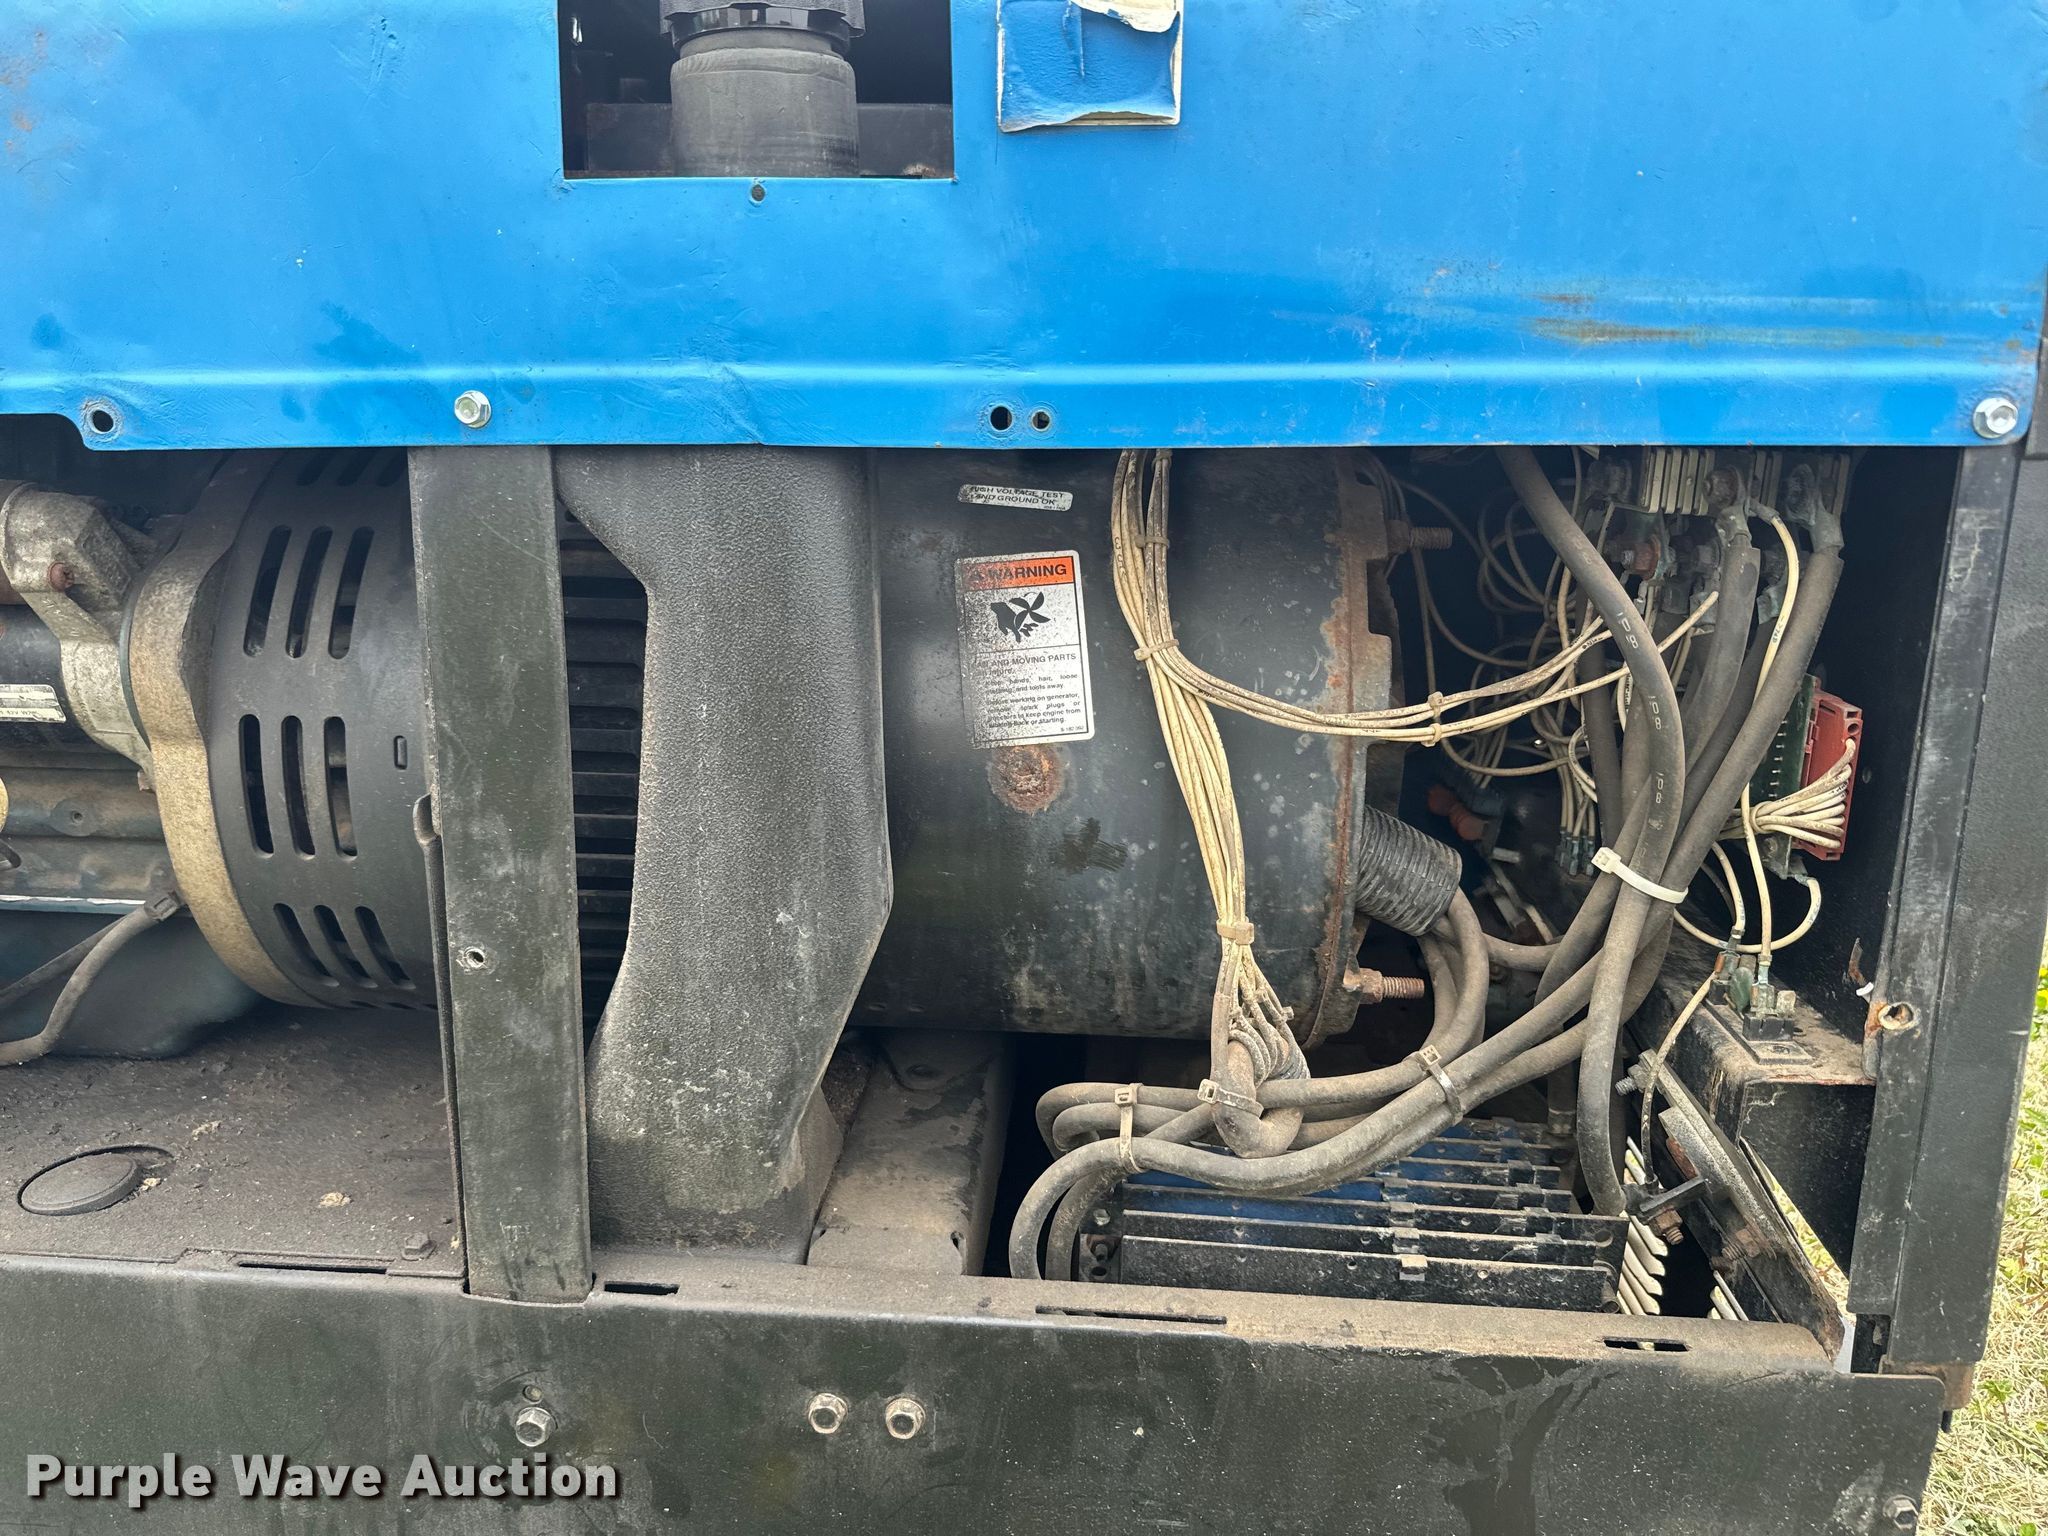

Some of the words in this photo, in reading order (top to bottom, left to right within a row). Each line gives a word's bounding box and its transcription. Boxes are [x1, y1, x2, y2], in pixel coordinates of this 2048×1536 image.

[996, 487, 1038, 497] VOLTAGE
[997, 494, 1039, 504] GROUND
[987, 563, 1067, 580] WARNING
[991, 659, 1009, 667] AND
[1011, 655, 1046, 666] MOVING
[1048, 653, 1077, 662] PARTS
[1047, 692, 1080, 701] generator,
[1046, 702, 1065, 710] plugs
[1026, 711, 1042, 719] keep
[1043, 709, 1064, 718] engine
